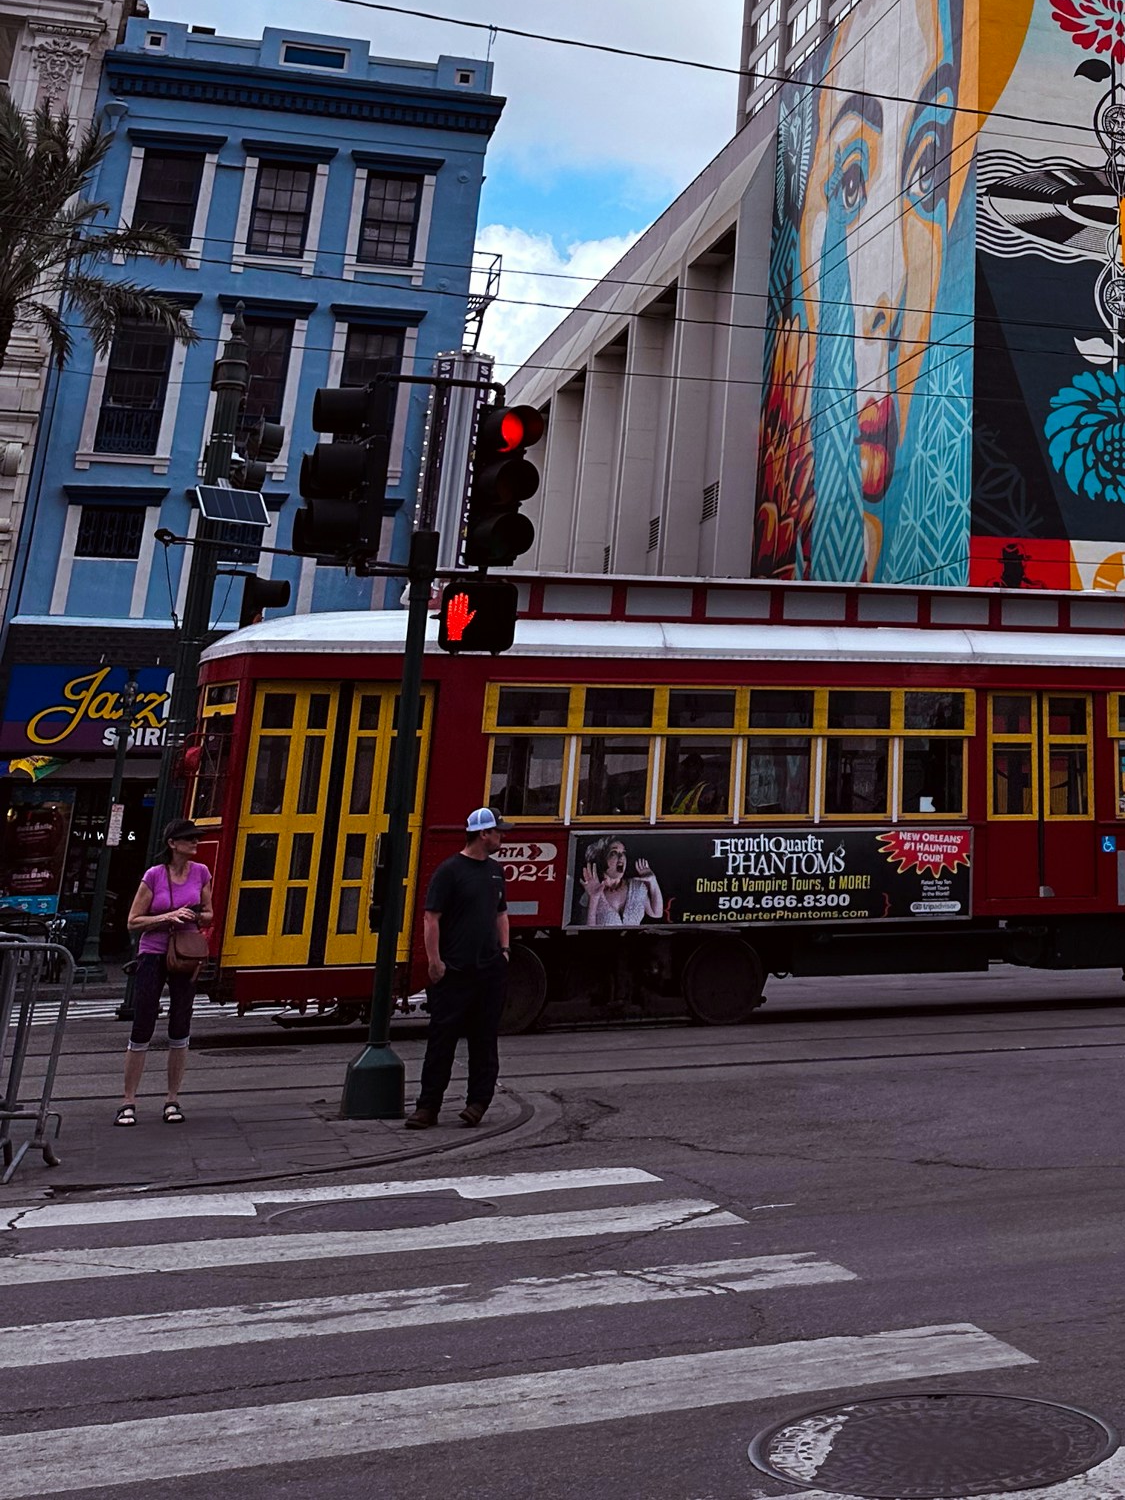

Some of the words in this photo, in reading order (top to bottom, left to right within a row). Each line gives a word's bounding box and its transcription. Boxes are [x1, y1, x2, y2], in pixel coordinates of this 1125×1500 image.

[899, 831, 920, 841] NEW
[498, 847, 524, 858] RTA
[903, 842, 915, 851] #1
[916, 843, 958, 854] HAUNTED
[725, 847, 846, 876] PHANTOMS
[917, 853, 944, 863] TOUR!
[695, 876, 728, 894] Ghost
[731, 877, 739, 892] &
[741, 877, 787, 895] Vampire
[790, 876, 825, 893] Tours,
[828, 876, 836, 890] &
[837, 875, 871, 891] MORE!
[717, 894, 850, 909] 504.666.8300
[683, 908, 869, 923] FrenchQuarterPhantoms.com
